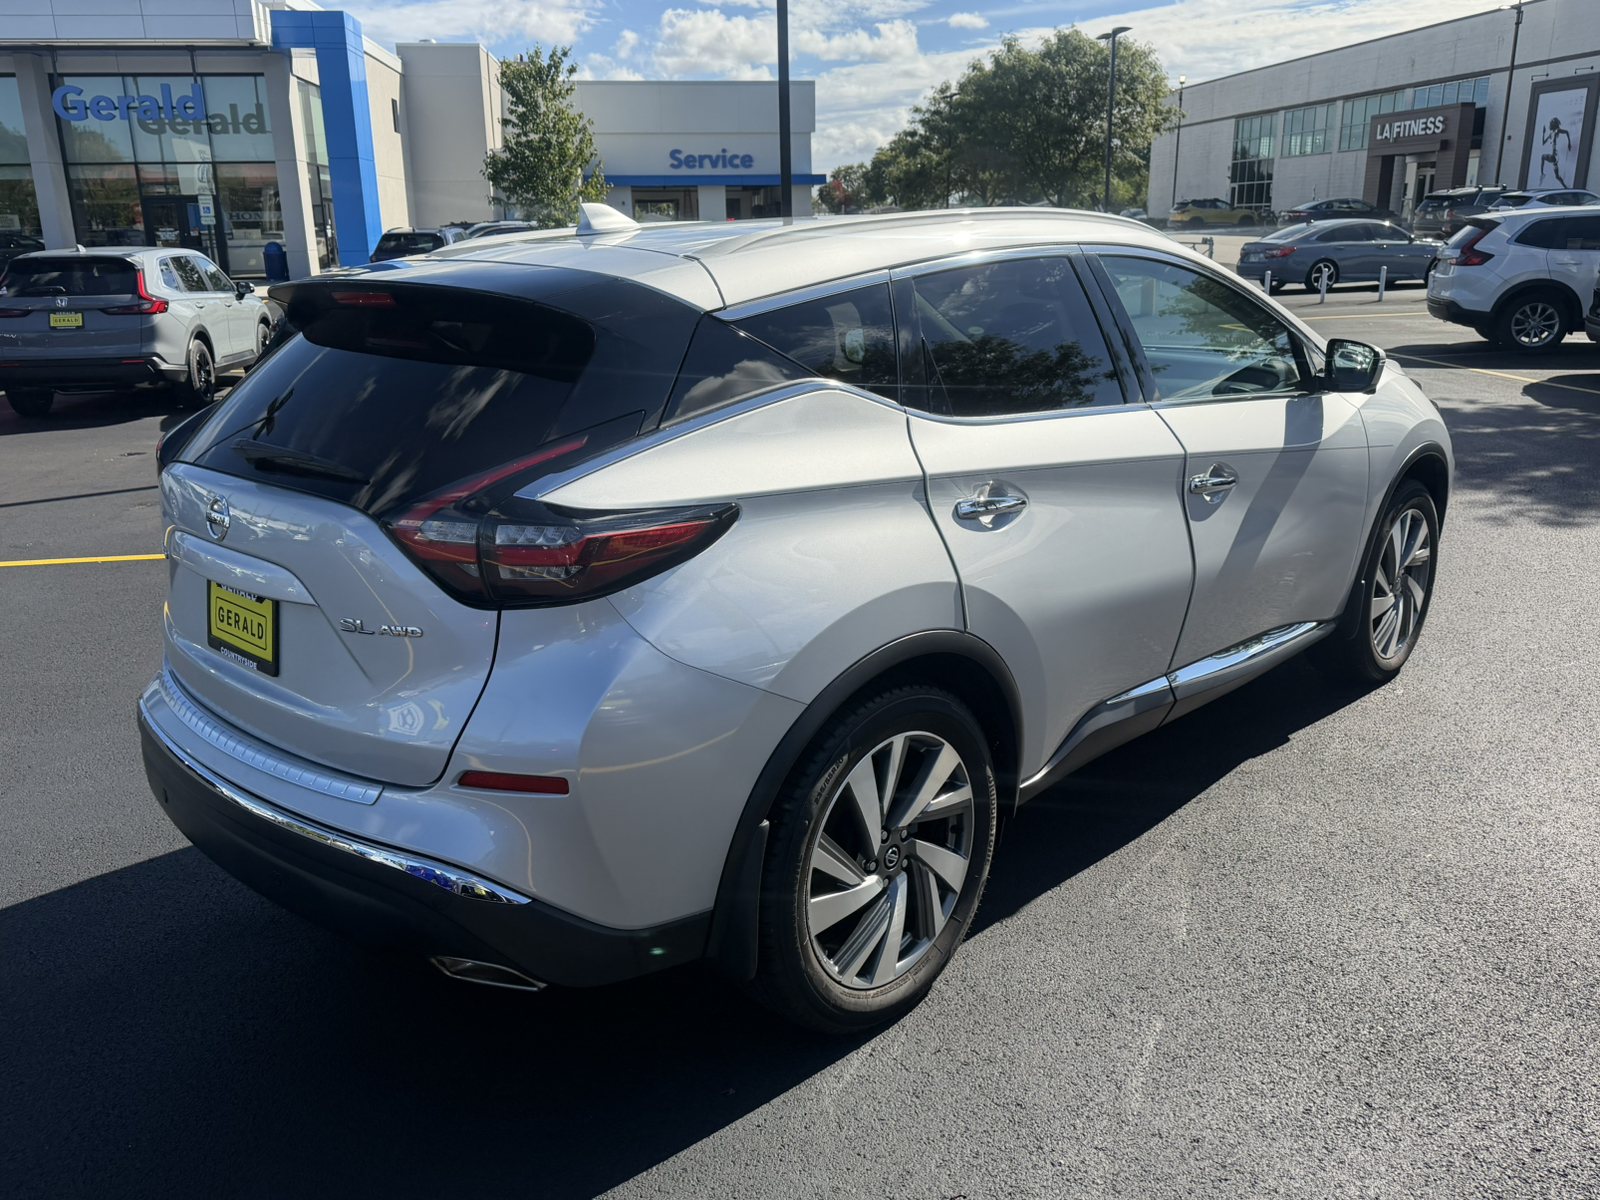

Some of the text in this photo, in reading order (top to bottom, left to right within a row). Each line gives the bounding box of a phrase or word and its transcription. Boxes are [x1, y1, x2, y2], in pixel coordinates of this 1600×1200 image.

[52, 83, 206, 121] Gerald
[669, 148, 754, 169] Service
[218, 606, 264, 640] GERALD
[340, 617, 423, 637] SL AWD
[220, 646, 258, 670] COUNTRYSIDE
